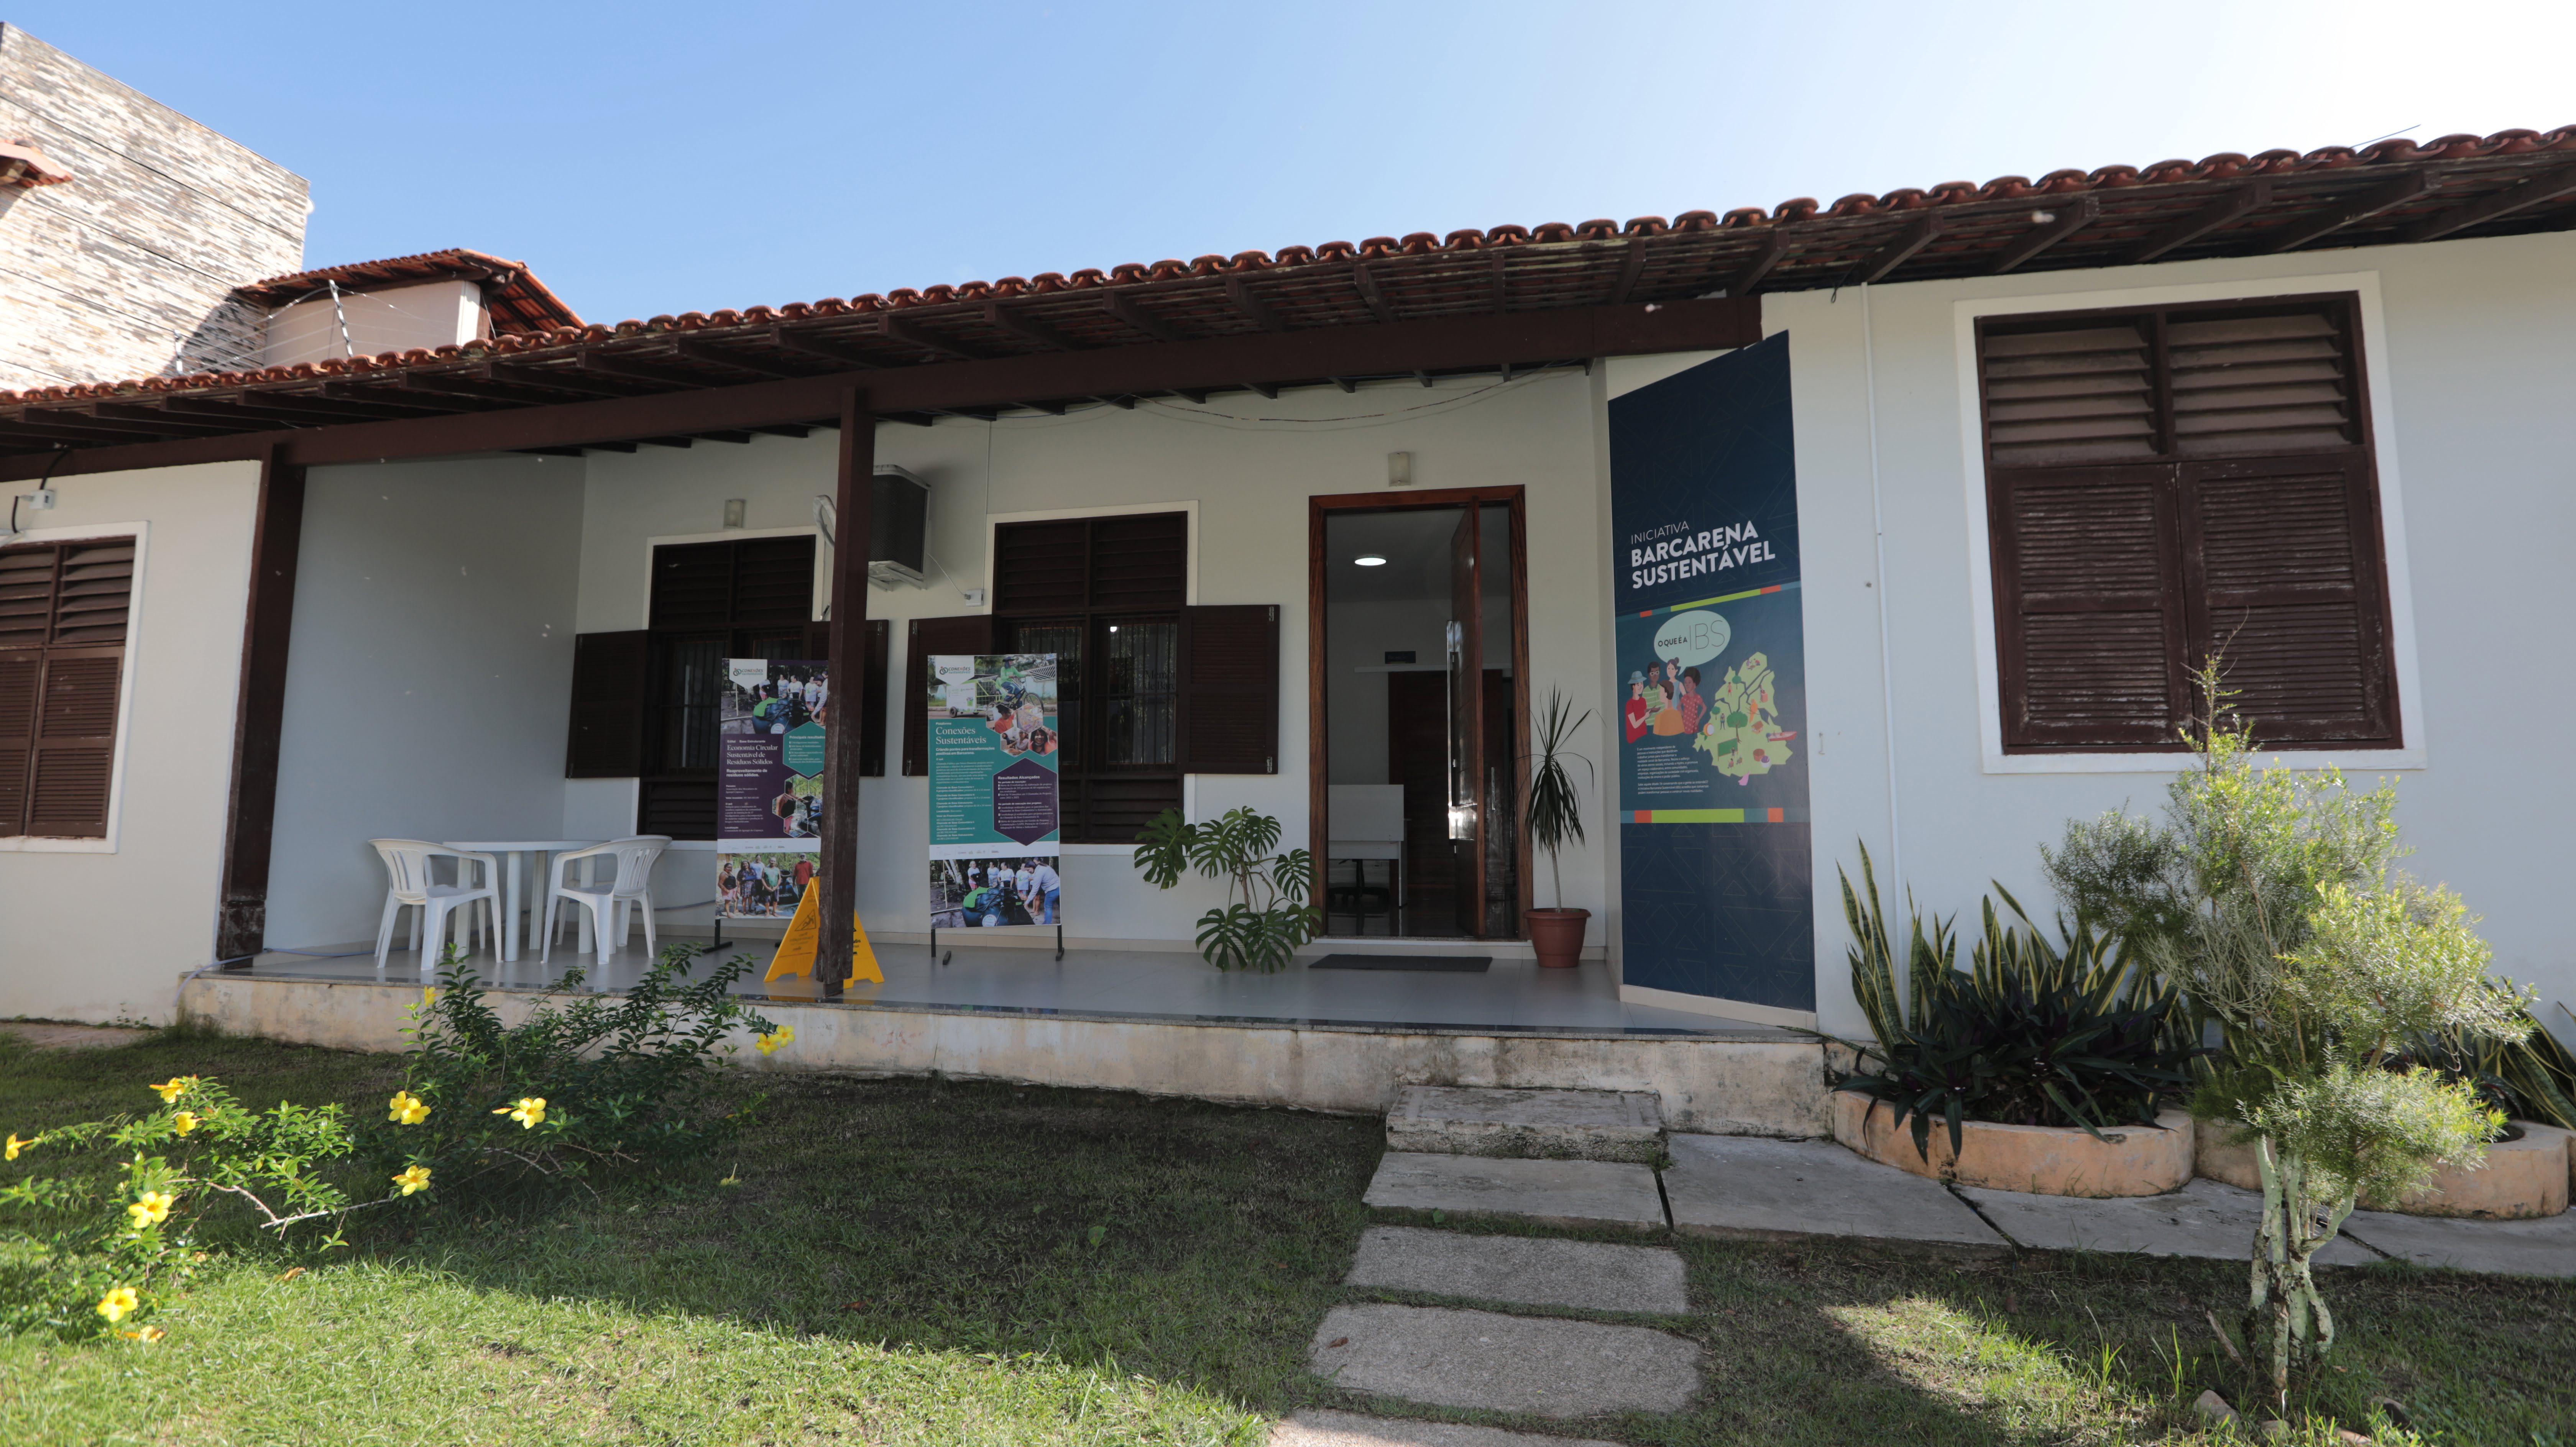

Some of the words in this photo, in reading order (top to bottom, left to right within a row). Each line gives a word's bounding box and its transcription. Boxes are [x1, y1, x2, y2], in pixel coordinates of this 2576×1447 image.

[1631, 521, 1689, 545] INICIATIVA
[1631, 520, 1758, 567] BARCARENA
[1632, 541, 1776, 589] SUSTENTÁVEL
[1664, 638, 1677, 647] QUE
[1679, 635, 1682, 643] É
[1689, 620, 1725, 650] IBS
[936, 736, 986, 744] Sustentáveis
